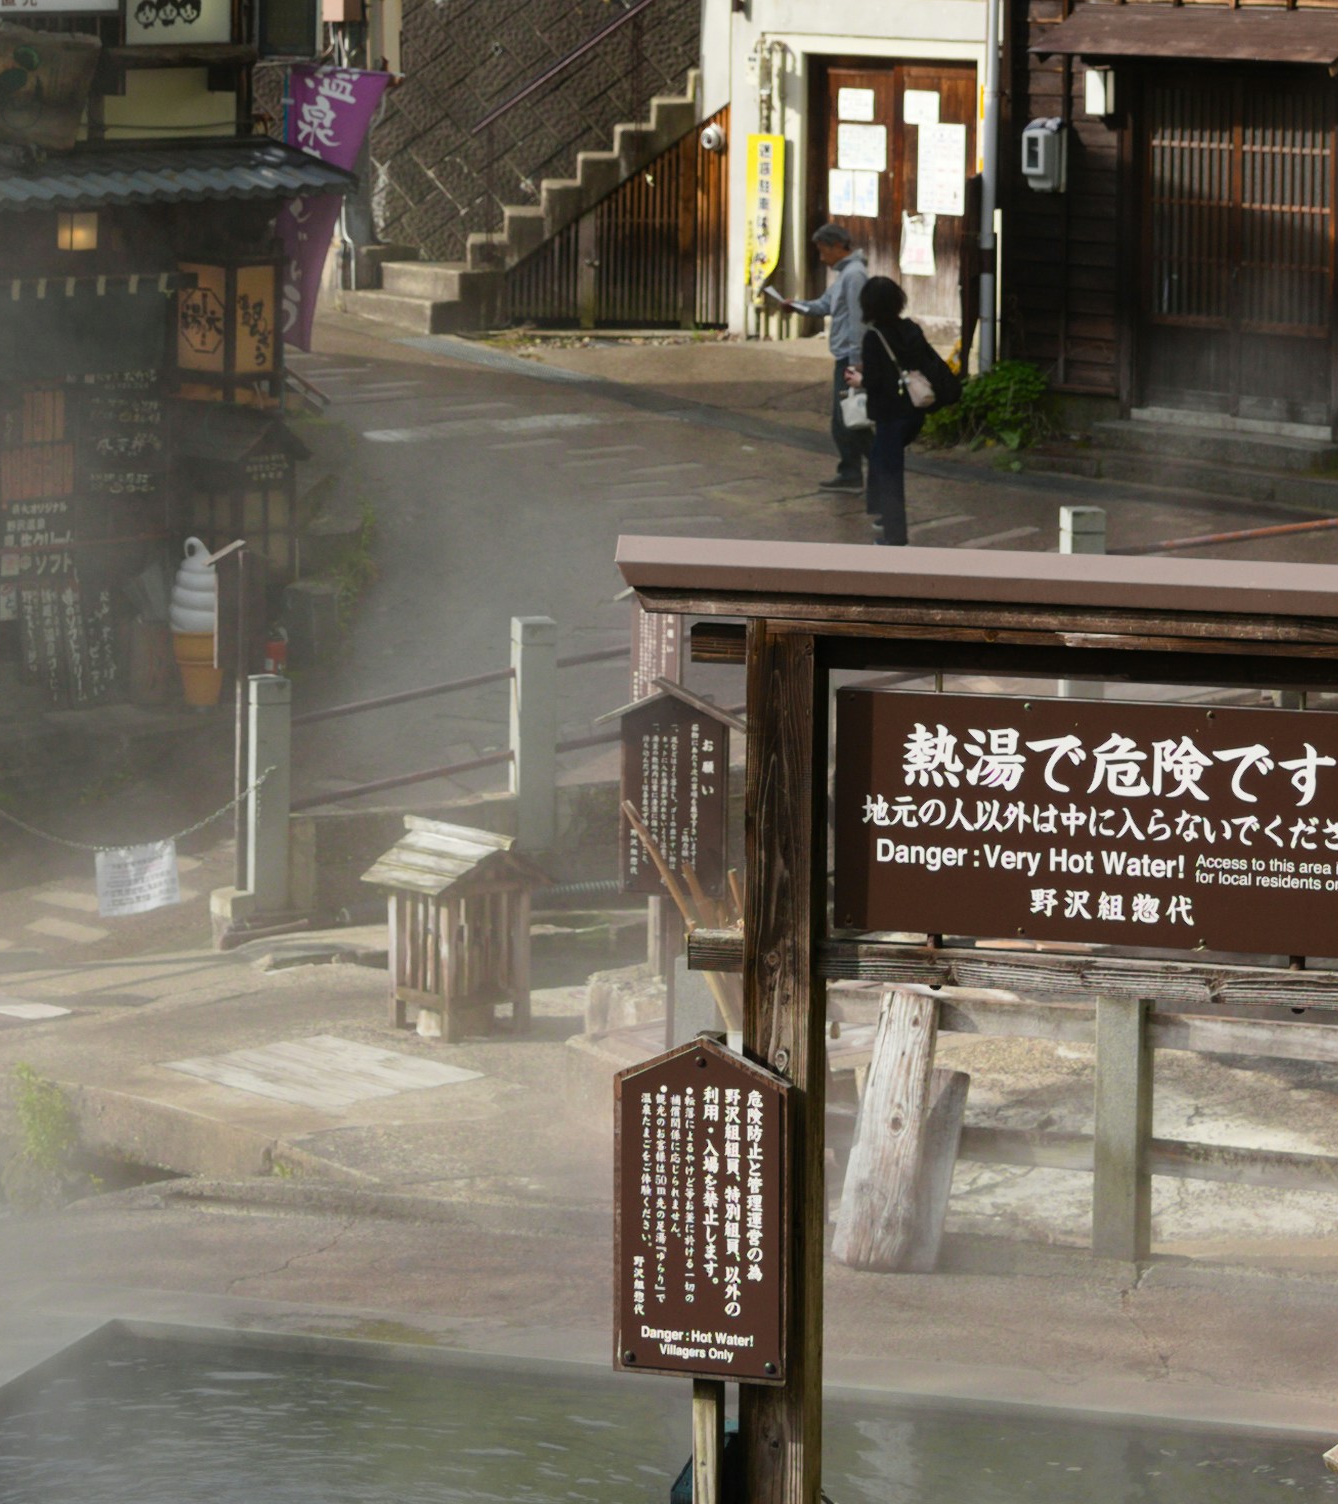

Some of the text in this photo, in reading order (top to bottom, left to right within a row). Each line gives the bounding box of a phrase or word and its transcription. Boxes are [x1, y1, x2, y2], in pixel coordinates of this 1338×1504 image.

[701, 738, 715, 796] お願い
[901, 723, 1337, 807] 熱湯で危険です
[983, 844, 1041, 877] Very
[1048, 848, 1094, 873] Hot
[1101, 850, 1186, 880] Water!
[1195, 854, 1248, 870] Access
[1251, 858, 1266, 871] to
[1269, 858, 1296, 873] this
[1299, 863, 1332, 876] area
[1195, 869, 1215, 885] for
[1218, 869, 1252, 887] local
[1256, 872, 1322, 891] residents
[1030, 887, 1195, 927] 野沢組惣代
[702, 1086, 720, 1286] 利用・入場を禁止します。
[724, 1088, 742, 1317] 野沢組組員、特別組員、以外の
[746, 1089, 764, 1282] 危険防止と管理運営の為
[633, 1255, 645, 1316] 野沢組惣代
[659, 1343, 734, 1364] Villagers Only
[691, 1329, 713, 1344] Hot
[715, 1331, 755, 1348] Water!
